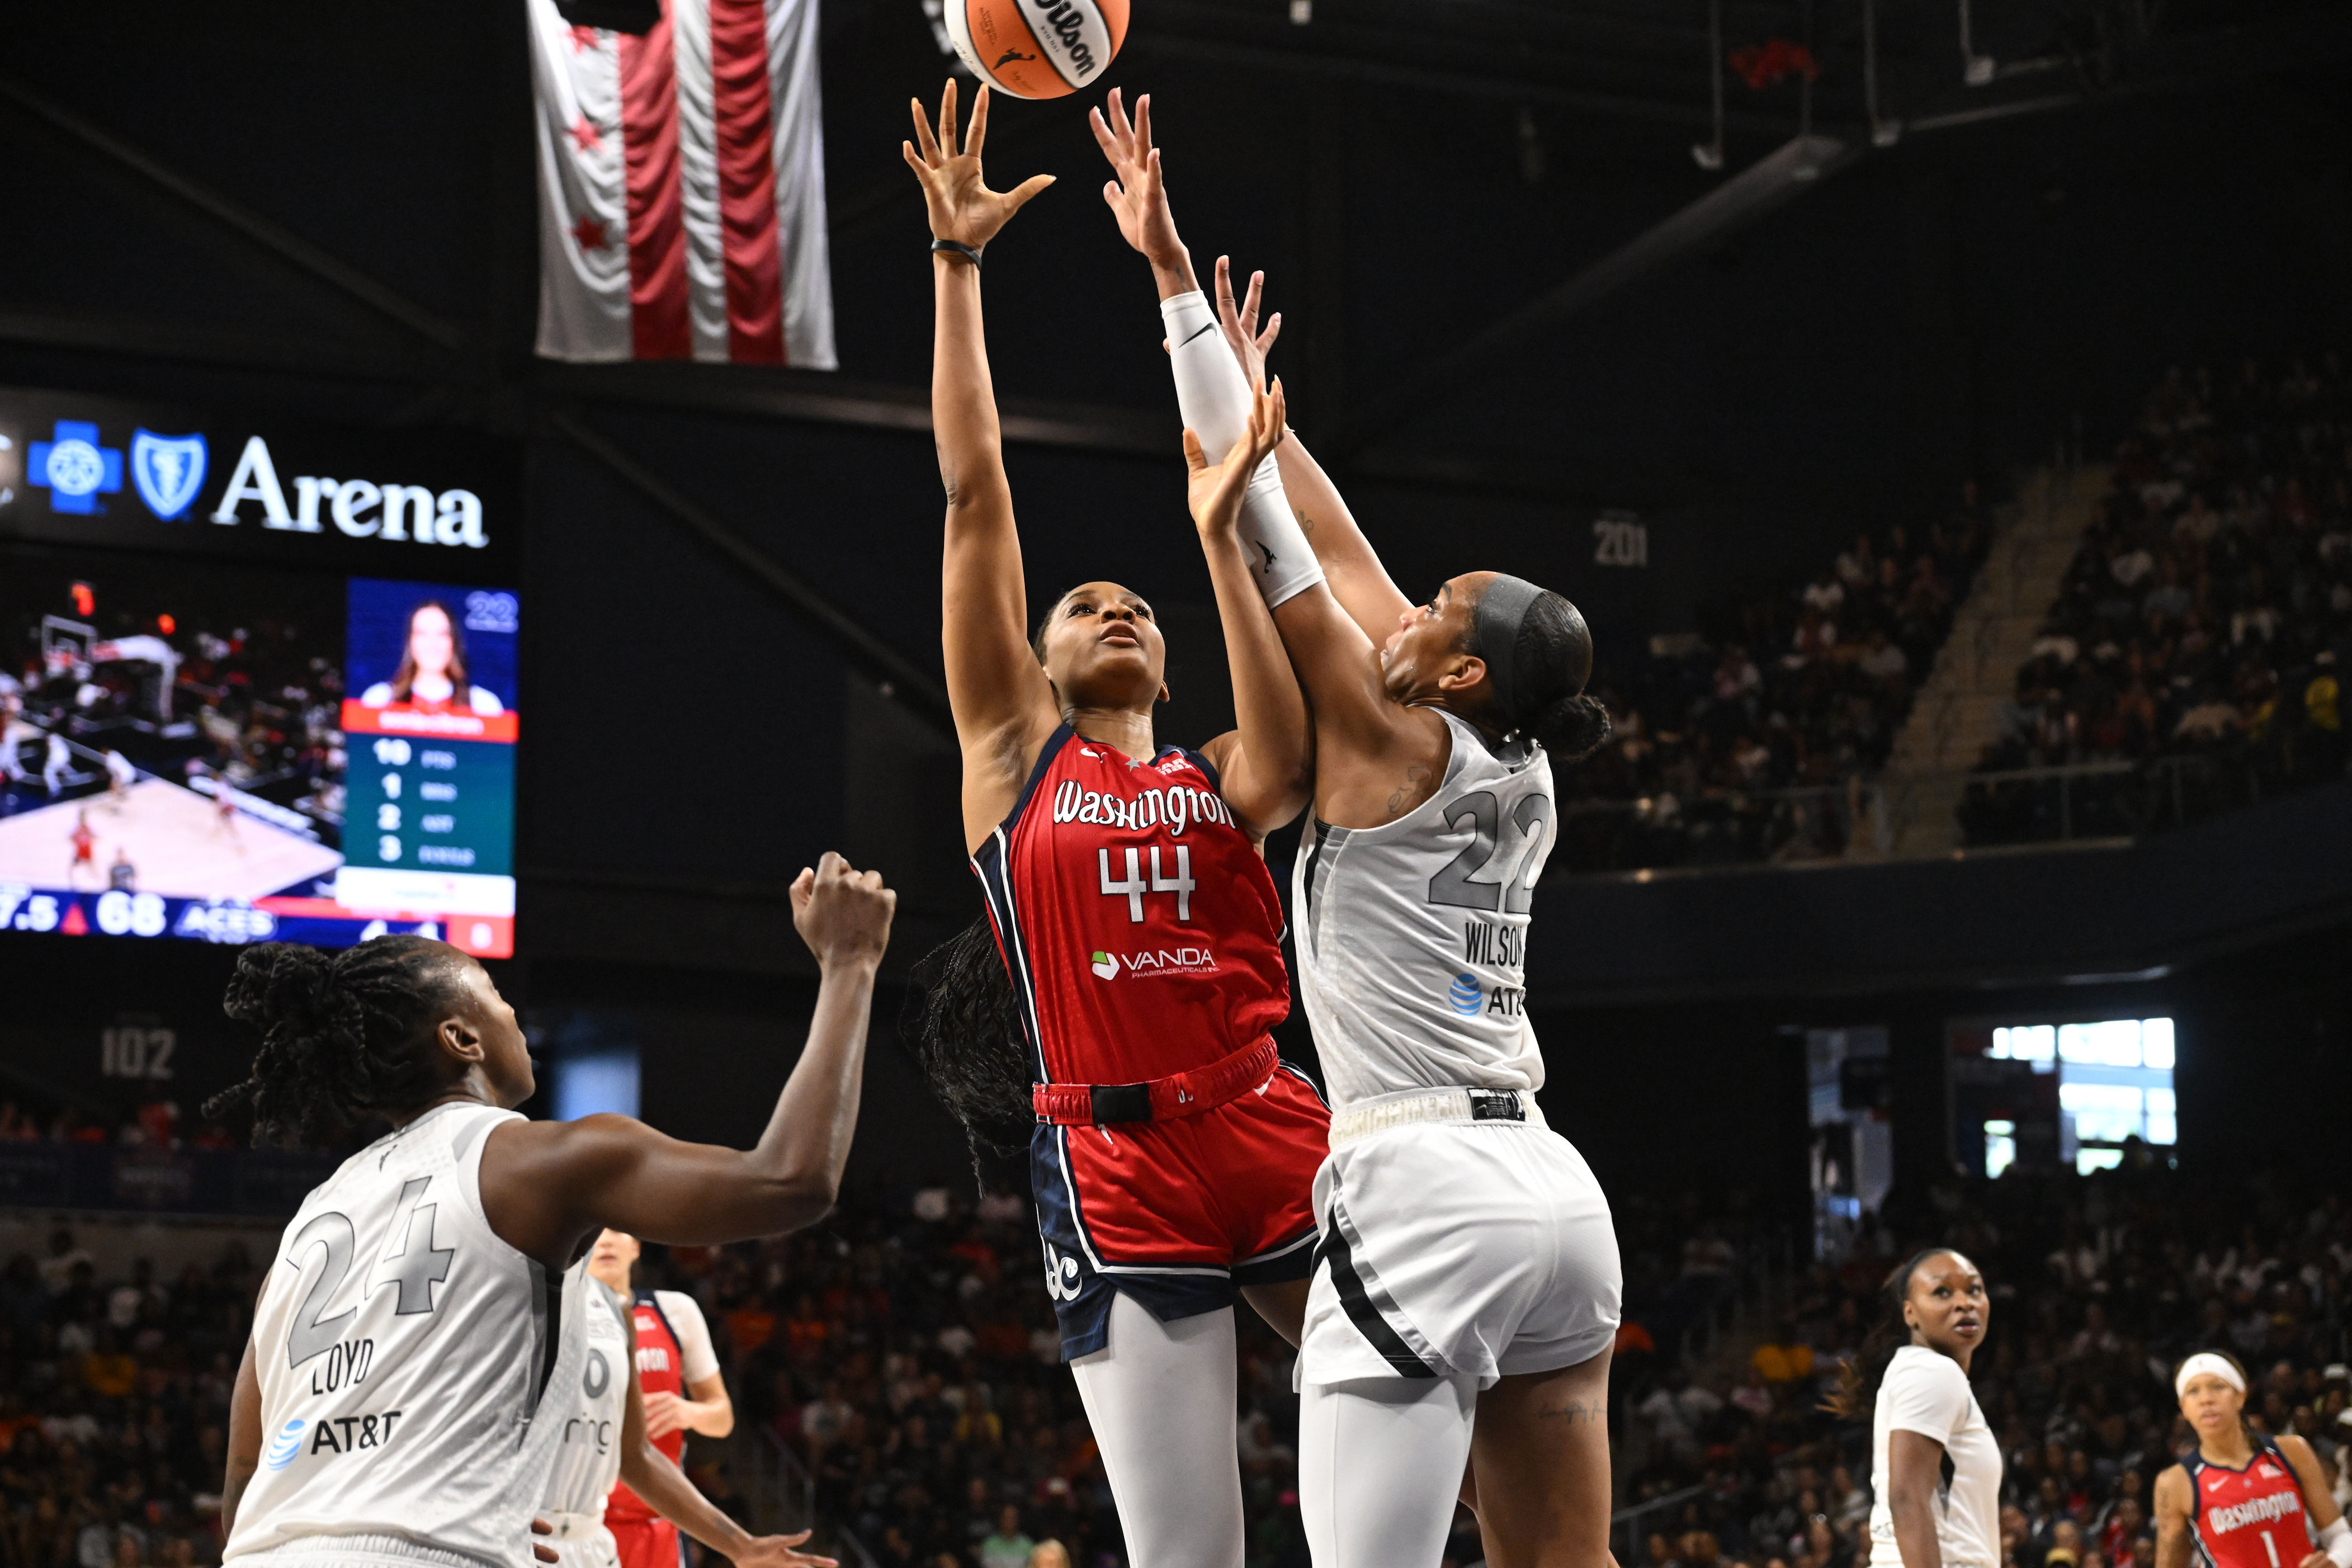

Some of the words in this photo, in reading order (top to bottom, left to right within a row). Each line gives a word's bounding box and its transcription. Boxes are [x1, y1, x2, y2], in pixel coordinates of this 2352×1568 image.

[210, 435, 490, 549] Arena
[1593, 520, 1649, 568] 201
[1054, 778, 1236, 837] Washington
[1428, 791, 1550, 914] 22
[1098, 844, 1196, 923] 44
[96, 891, 166, 937] 68
[1121, 948, 1216, 971] VANDA
[1465, 922, 1523, 967] WILSON
[1131, 967, 1207, 979] PHARMACEUTICALS
[103, 1028, 177, 1079] 102
[286, 1175, 455, 1369] 24
[312, 1338, 374, 1396] LOYD
[311, 1411, 402, 1455] AT&T
[2260, 1529, 2280, 1568] 1
